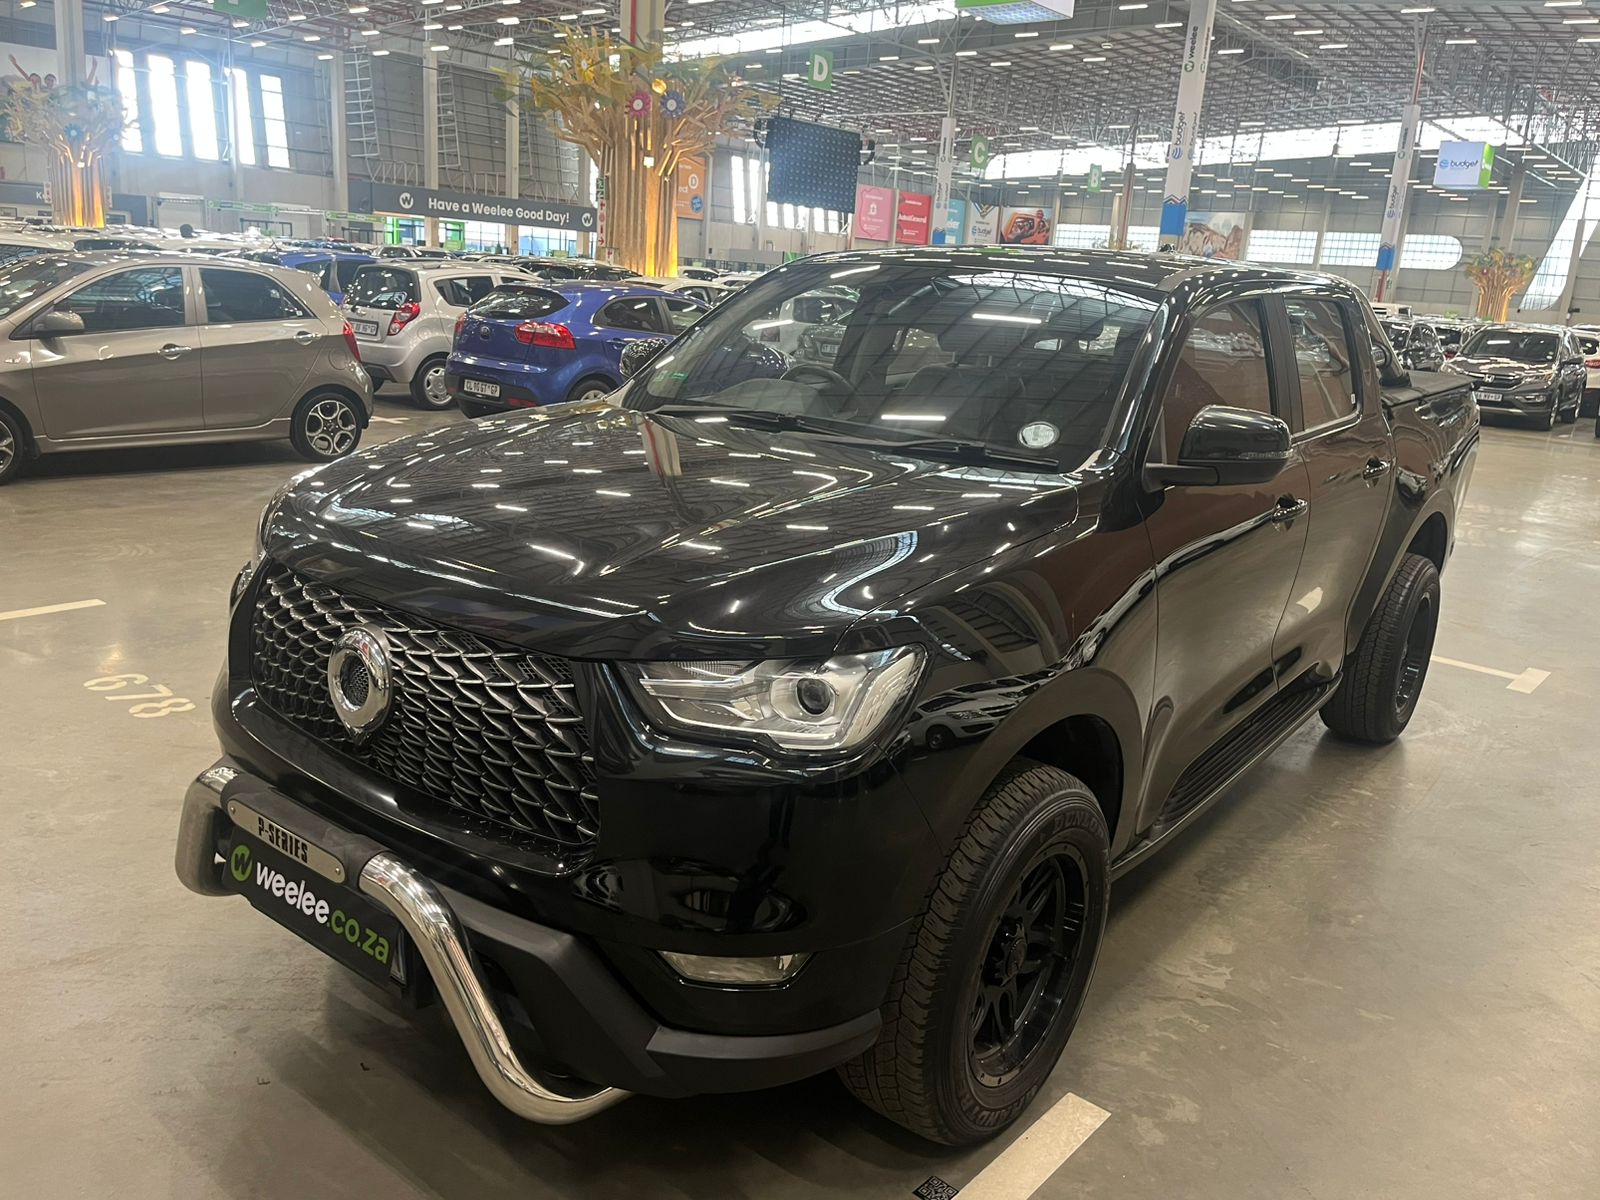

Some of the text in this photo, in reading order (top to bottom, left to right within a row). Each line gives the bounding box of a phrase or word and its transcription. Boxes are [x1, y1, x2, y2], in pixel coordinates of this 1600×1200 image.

[1188, 26, 1199, 59] weelee
[813, 54, 829, 82] D
[1175, 112, 1188, 146] budget
[974, 142, 986, 164] C
[1091, 168, 1100, 188] B
[428, 197, 570, 226] Have a Weelee Good Day!
[83, 673, 196, 718] 678
[257, 816, 309, 864] P-SERIES
[1054, 810, 1105, 839] DUNLOP
[256, 861, 390, 964] weelee.co.za
